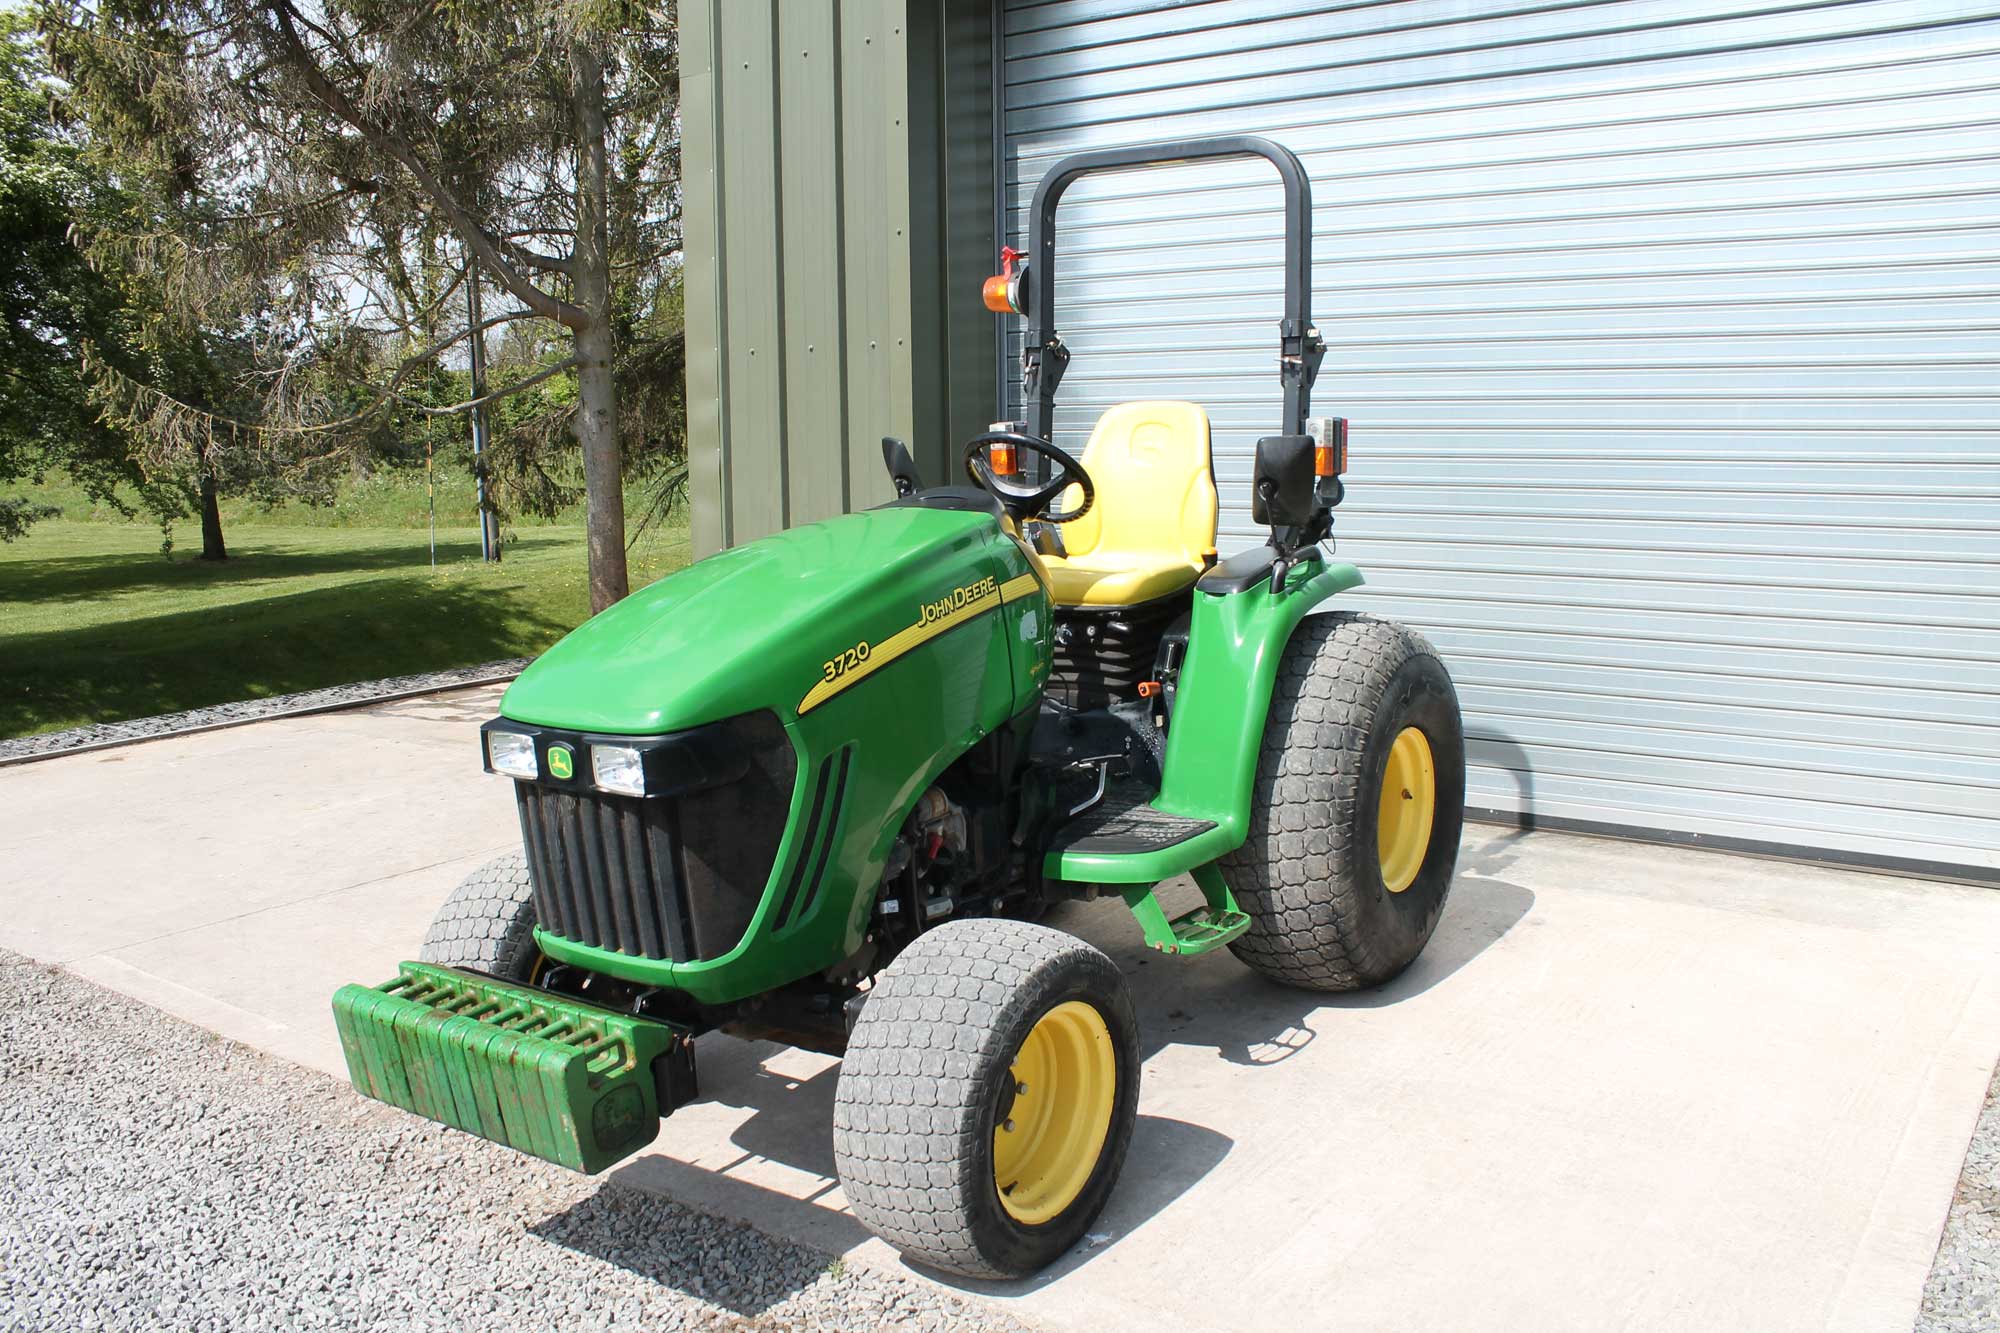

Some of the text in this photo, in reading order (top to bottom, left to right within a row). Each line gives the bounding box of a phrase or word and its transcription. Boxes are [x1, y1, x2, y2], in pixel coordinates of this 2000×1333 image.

[918, 575, 996, 627] JOHN DEERE
[823, 641, 869, 681] 3720
